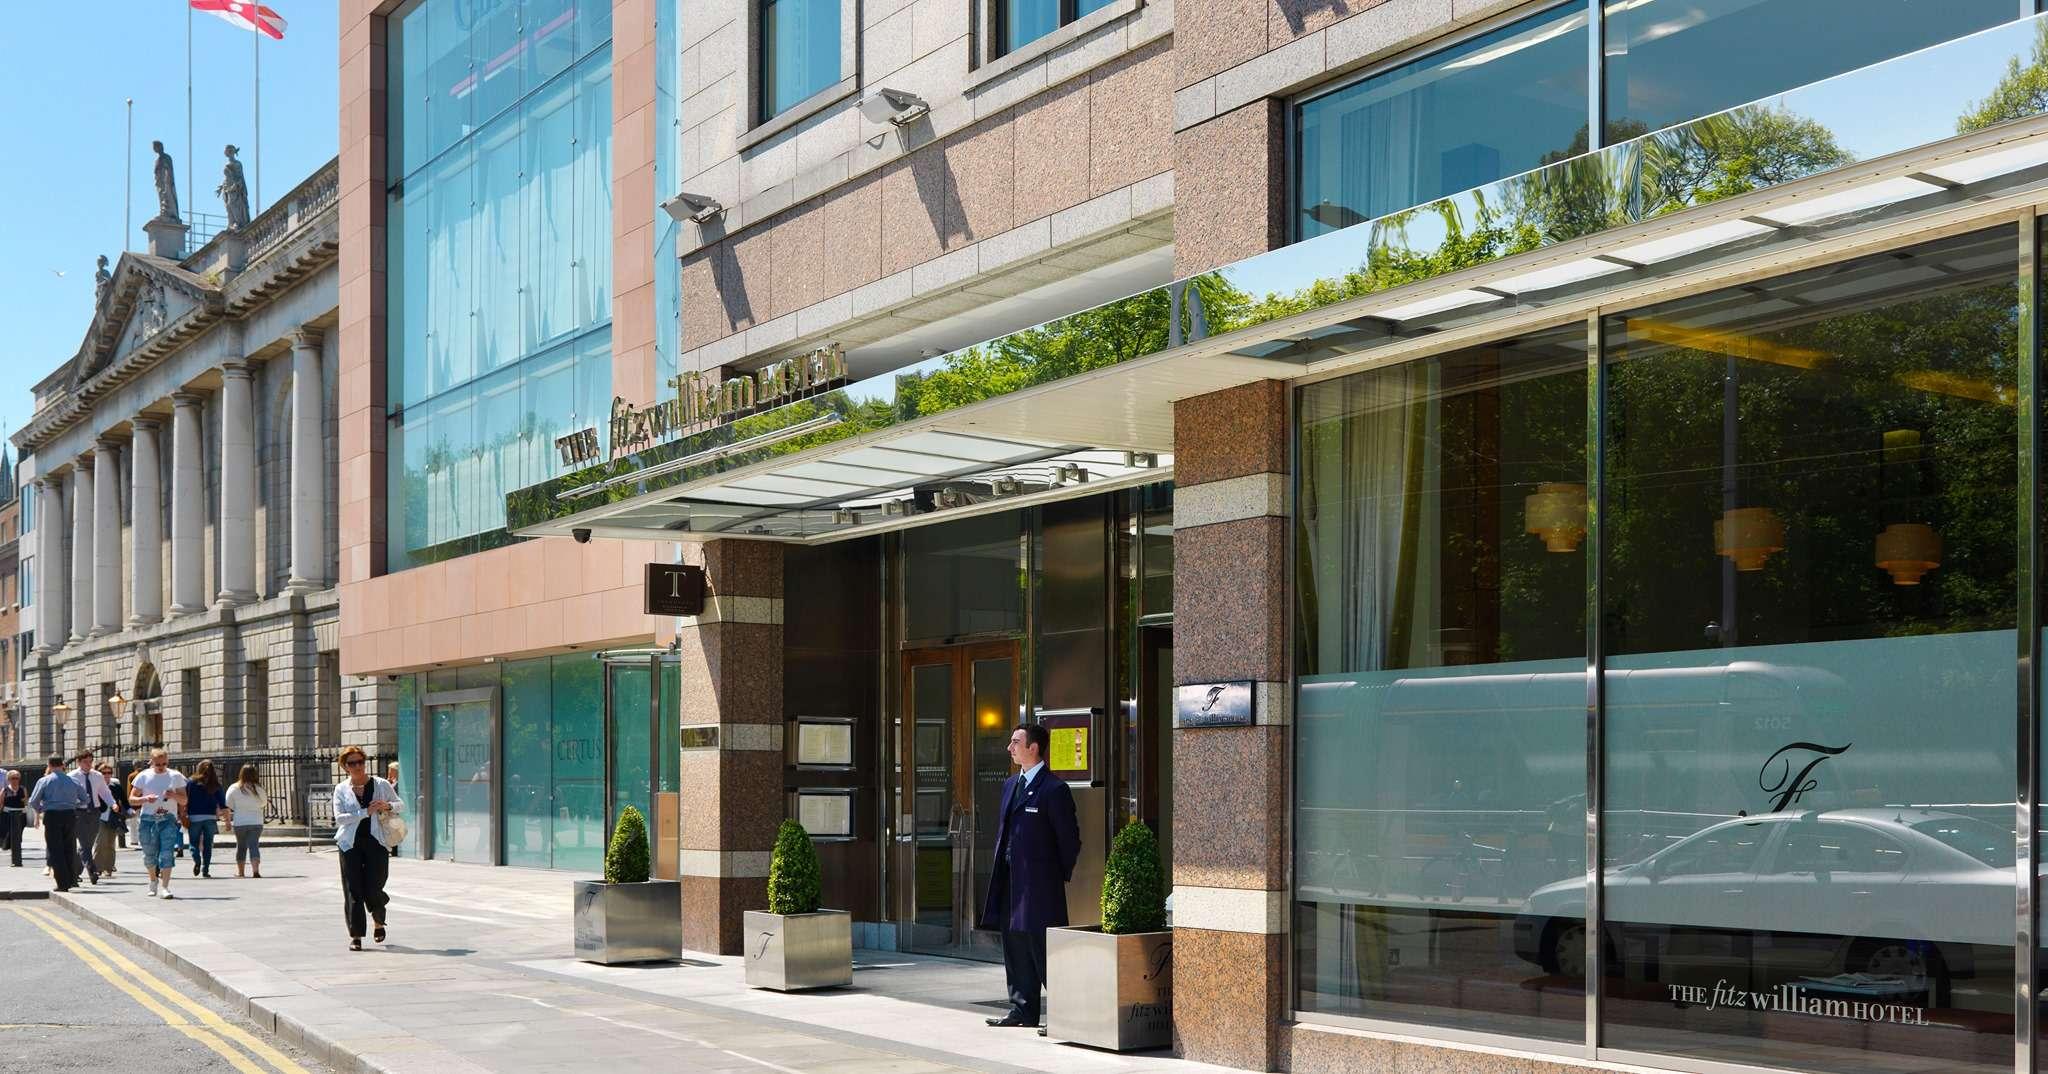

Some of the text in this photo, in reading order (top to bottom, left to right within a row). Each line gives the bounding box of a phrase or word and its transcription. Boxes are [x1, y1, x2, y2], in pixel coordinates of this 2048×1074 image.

[555, 427, 601, 467] THE
[664, 571, 687, 598] T
[458, 743, 490, 766] CERTU
[557, 738, 601, 764] CERTUS
[1669, 984, 1707, 1004] THE
[1854, 1002, 1929, 1026] HOTEL
